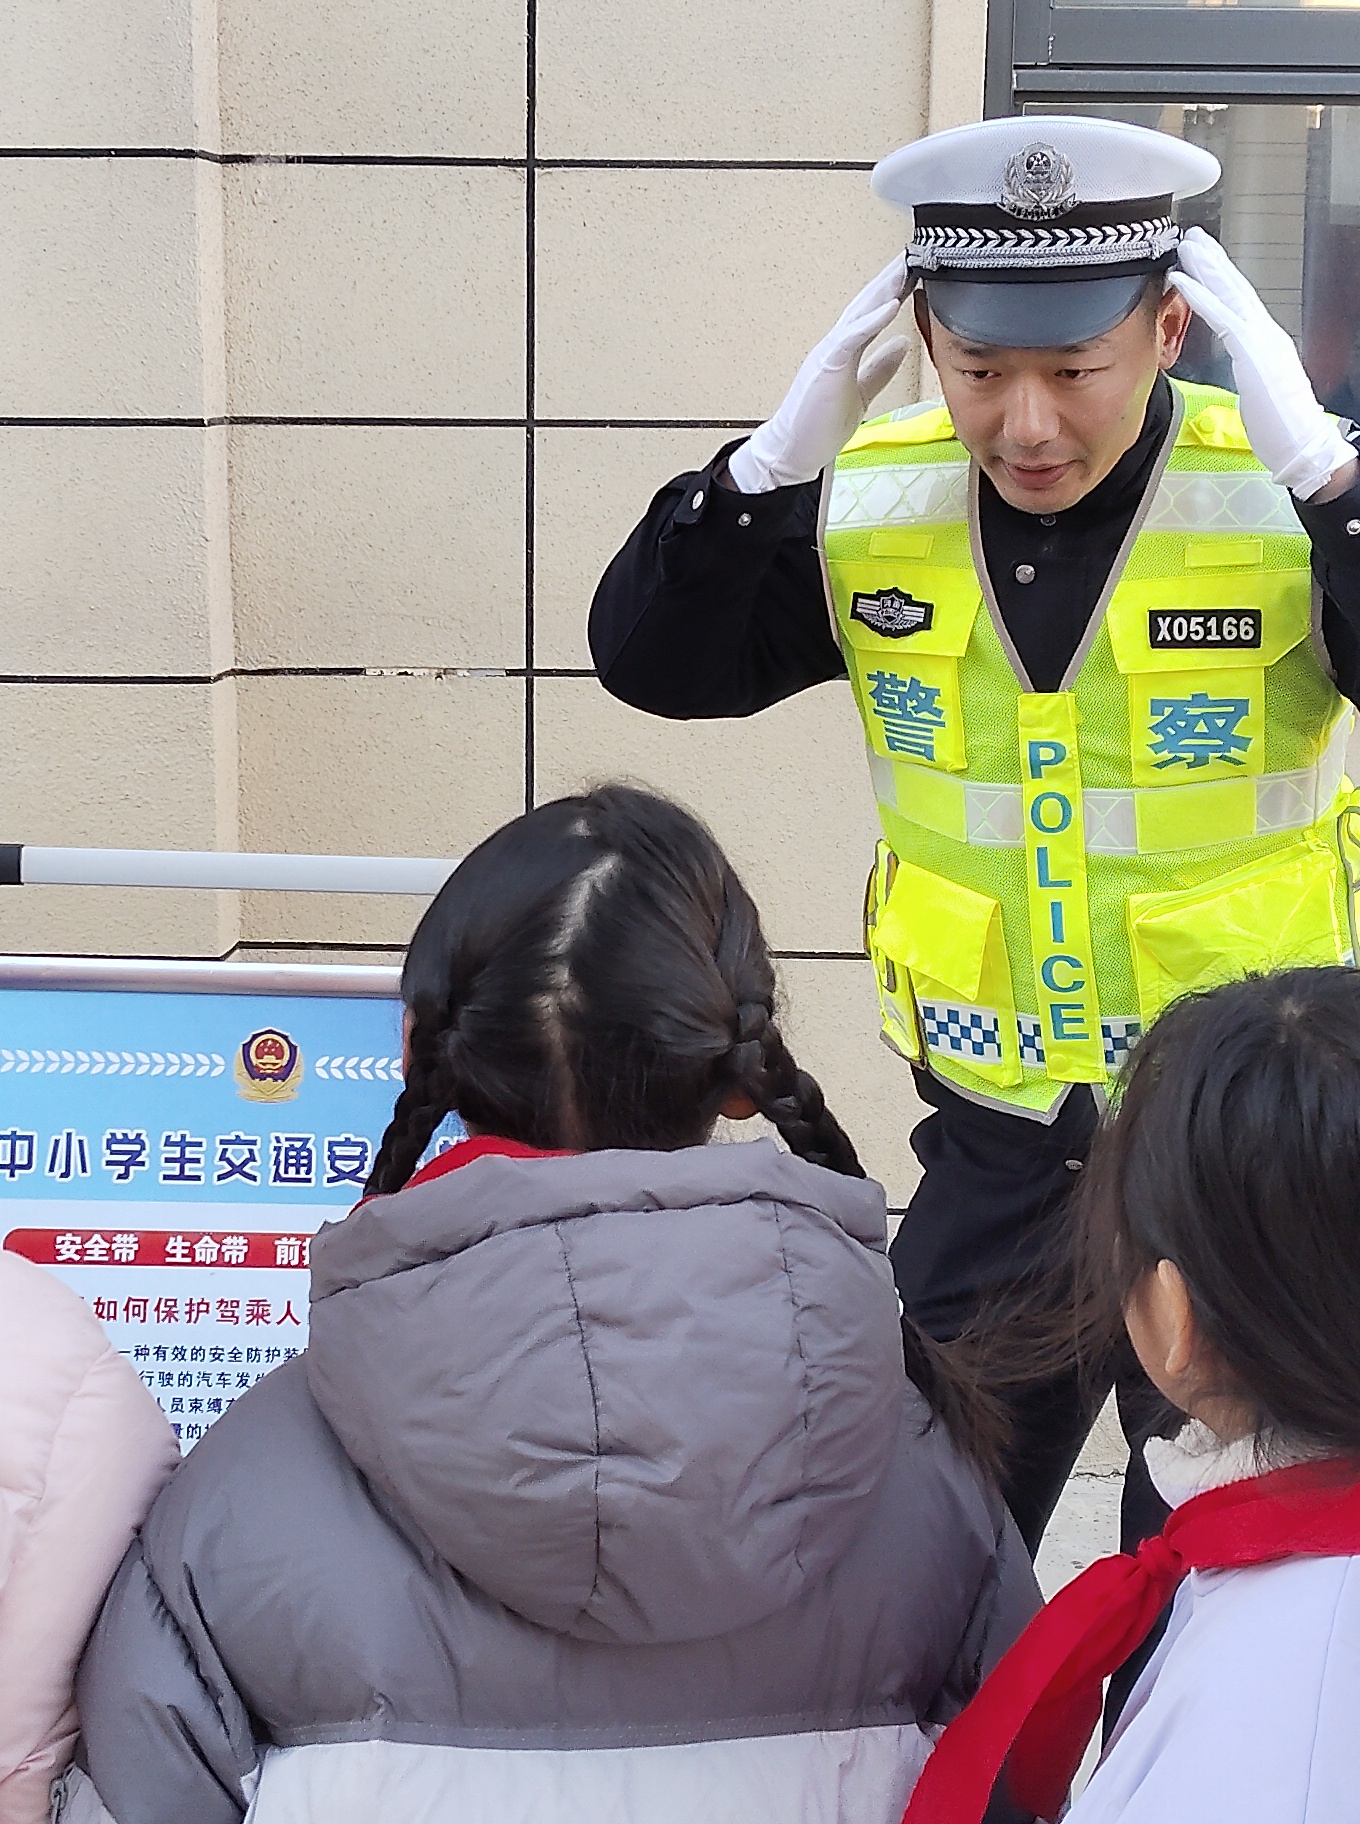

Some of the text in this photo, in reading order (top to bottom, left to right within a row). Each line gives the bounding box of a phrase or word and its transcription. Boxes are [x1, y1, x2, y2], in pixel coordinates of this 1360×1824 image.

[1156, 616, 1255, 641] X05166
[866, 669, 1253, 771] 警 察
[1027, 740, 1090, 1041] POLICE
[55, 1233, 139, 1264] 安全带
[165, 1234, 248, 1265] 生命带
[79, 1296, 302, 1326] 如何保护驾乘人
[118, 1345, 309, 1363] 一种有效的安全防护装
